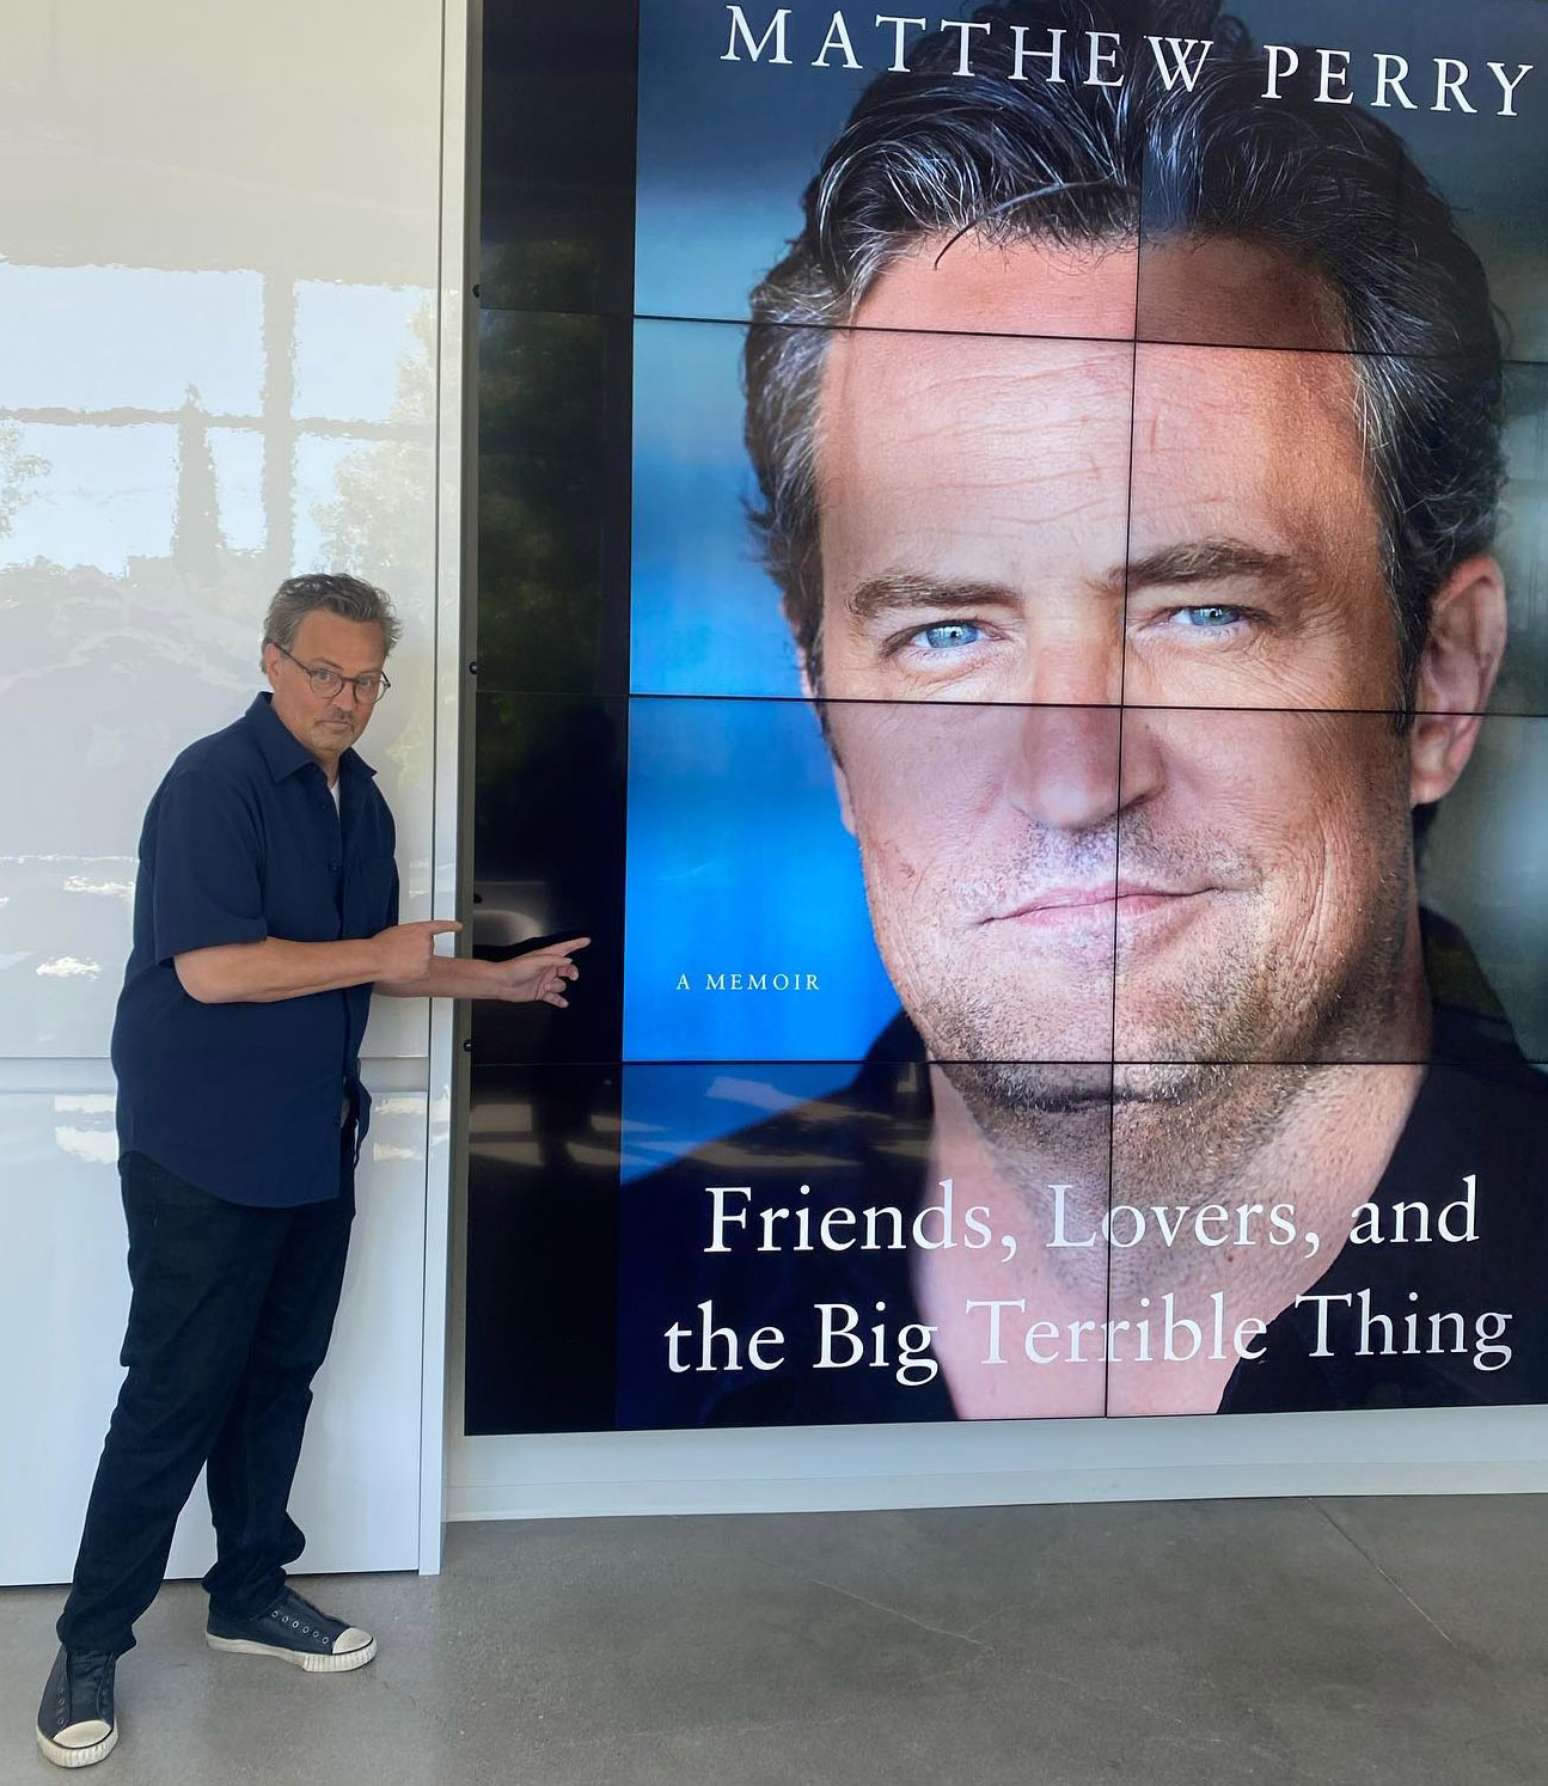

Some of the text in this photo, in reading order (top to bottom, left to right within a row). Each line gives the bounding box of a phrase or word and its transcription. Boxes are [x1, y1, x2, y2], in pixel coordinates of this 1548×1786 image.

[720, 5, 1534, 117] MATTHEW PERRY
[676, 973, 819, 991] A MEMOIR
[703, 1174, 1480, 1263] Friends, Lovers, and
[664, 1291, 1514, 1387] the Big Terrible Thing
